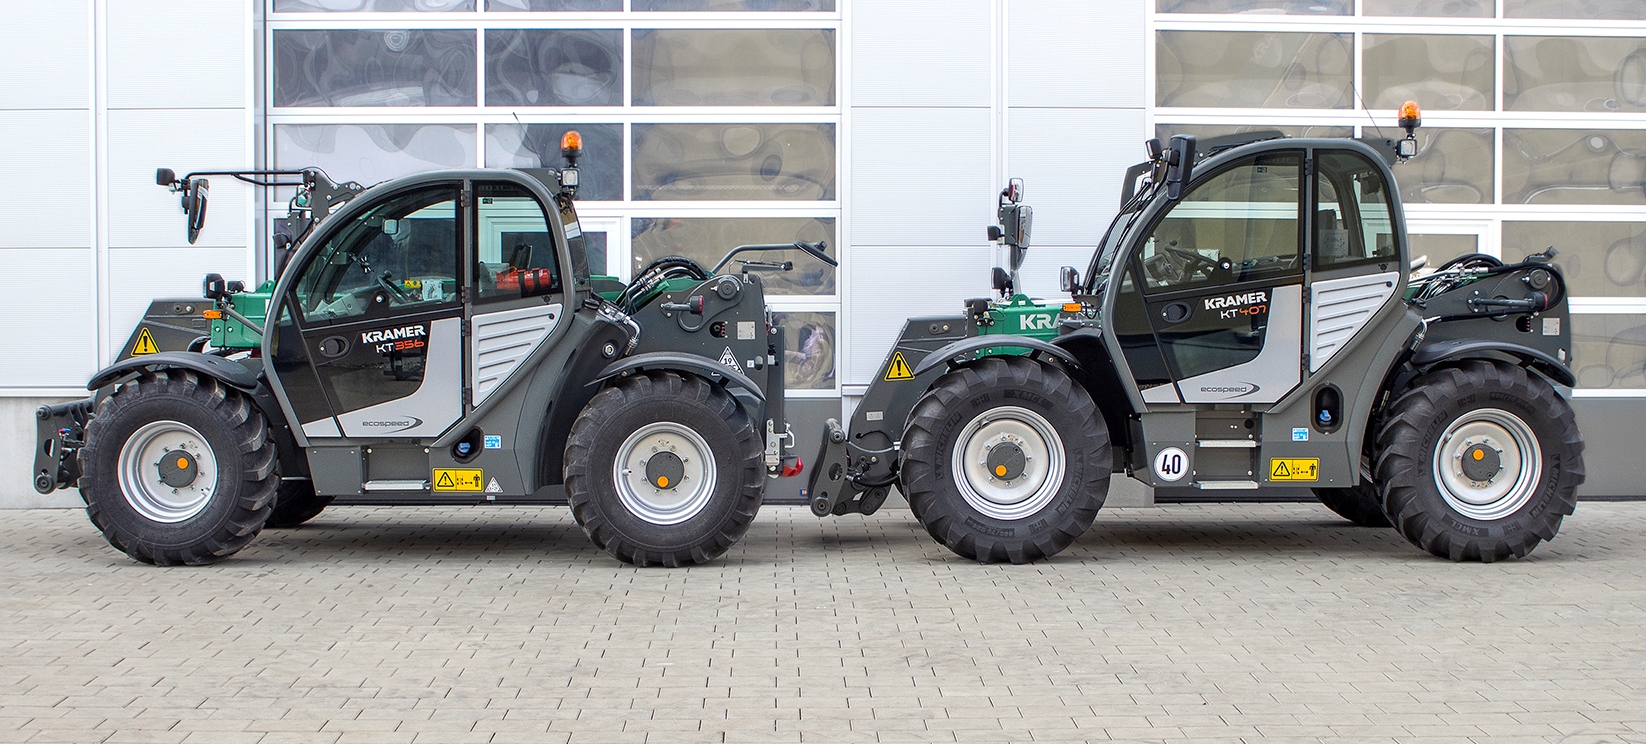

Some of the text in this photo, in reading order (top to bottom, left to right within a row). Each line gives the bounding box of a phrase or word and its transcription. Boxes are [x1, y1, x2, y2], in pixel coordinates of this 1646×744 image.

[1204, 291, 1268, 311] KRAMER
[361, 324, 426, 344] KRAMER
[1200, 385, 1248, 394] ecospeed
[362, 419, 410, 428] ecospeed
[936, 411, 961, 466] MICHELIN
[1418, 410, 1448, 463] MICHELIN
[1161, 453, 1182, 475] 40
[1056, 465, 1084, 515] MICHELIN
[1529, 466, 1560, 518] MICHELIN
